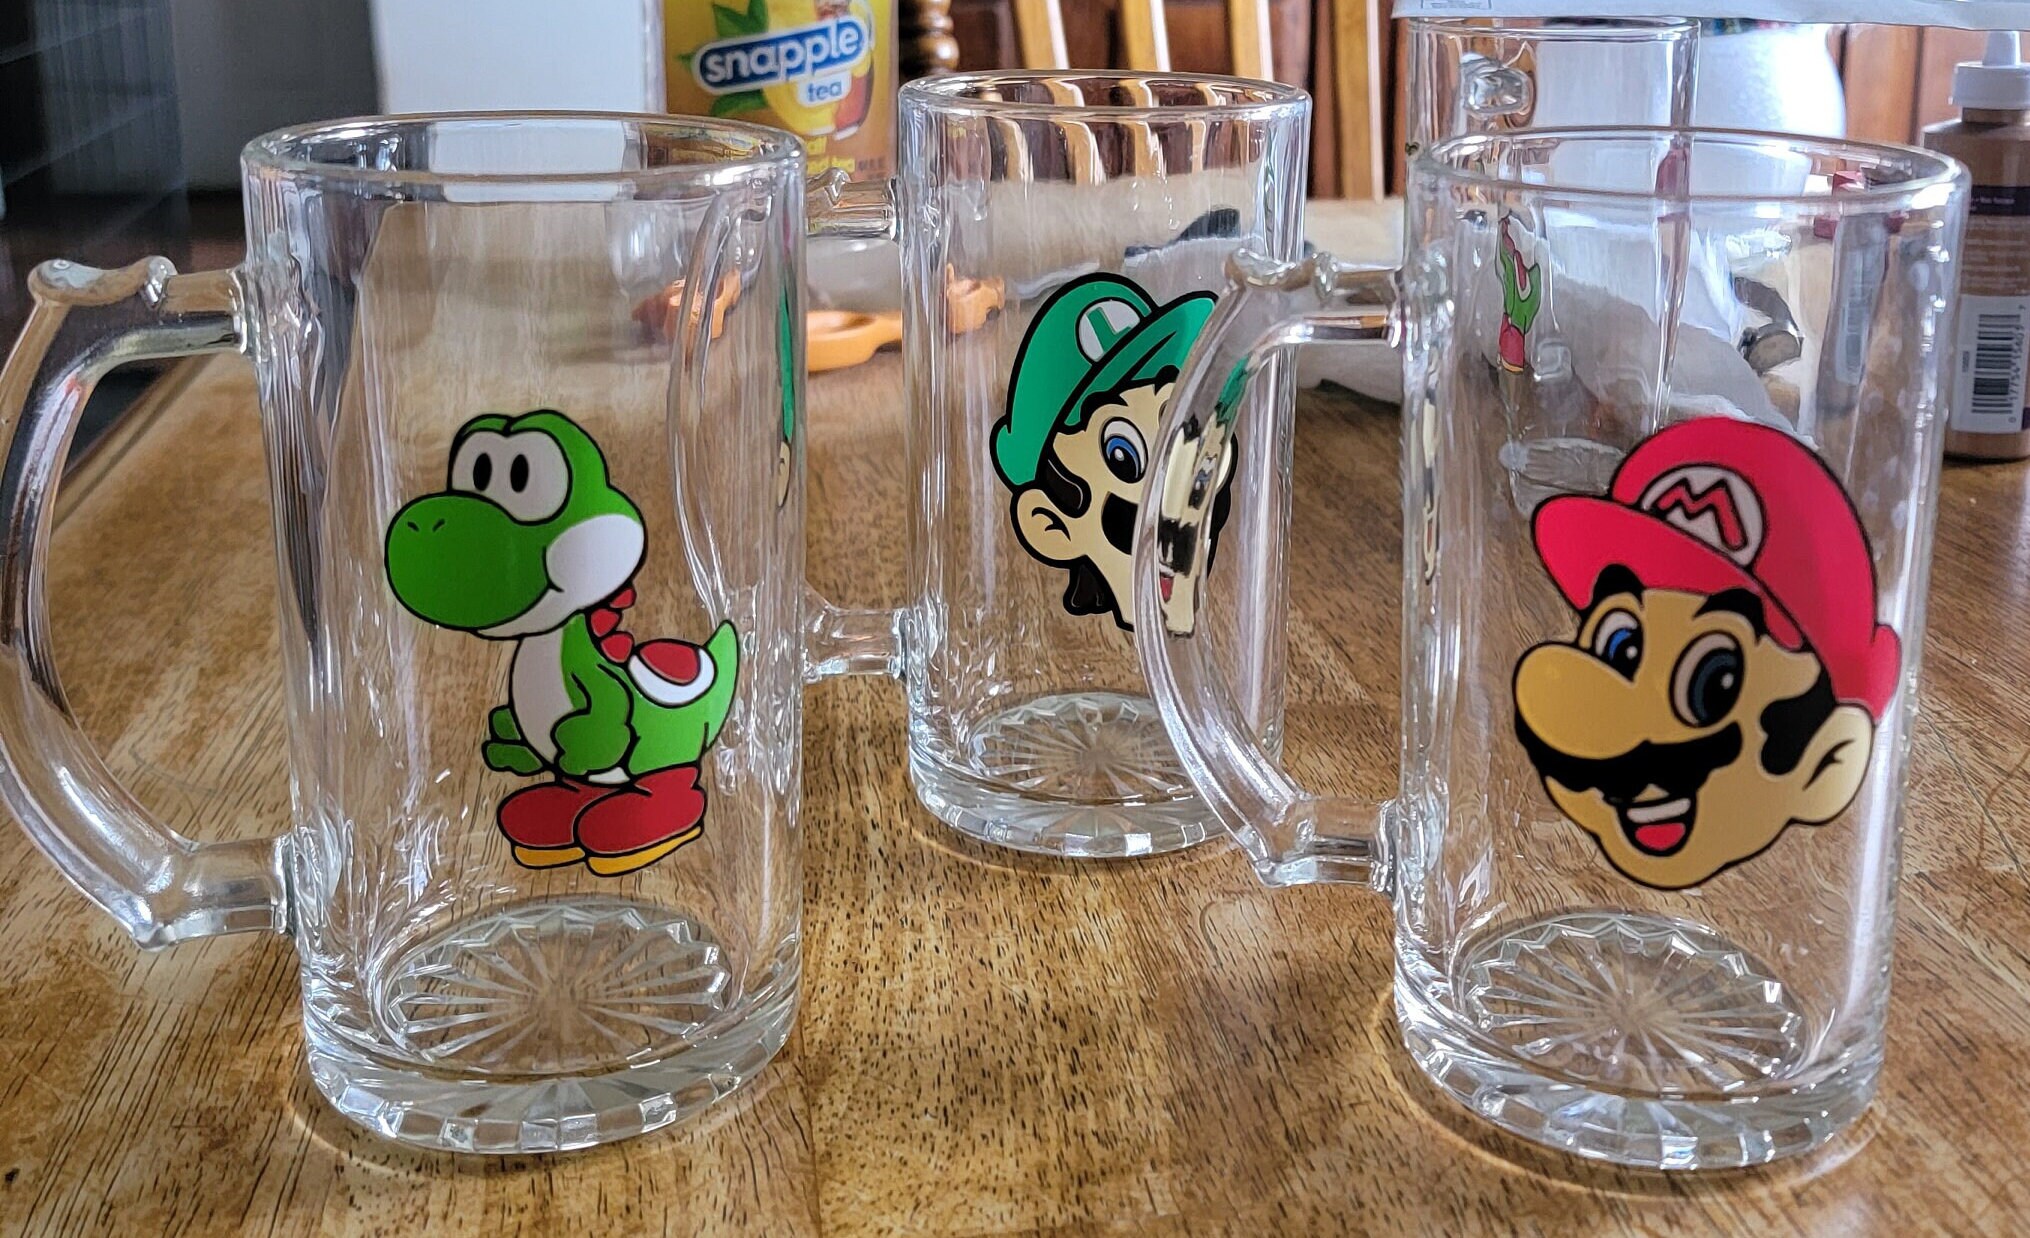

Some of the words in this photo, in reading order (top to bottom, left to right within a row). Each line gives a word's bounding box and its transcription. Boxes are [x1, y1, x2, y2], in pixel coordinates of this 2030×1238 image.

[705, 20, 859, 83] snapple
[807, 80, 842, 100] tea
[1652, 477, 1748, 551] M
